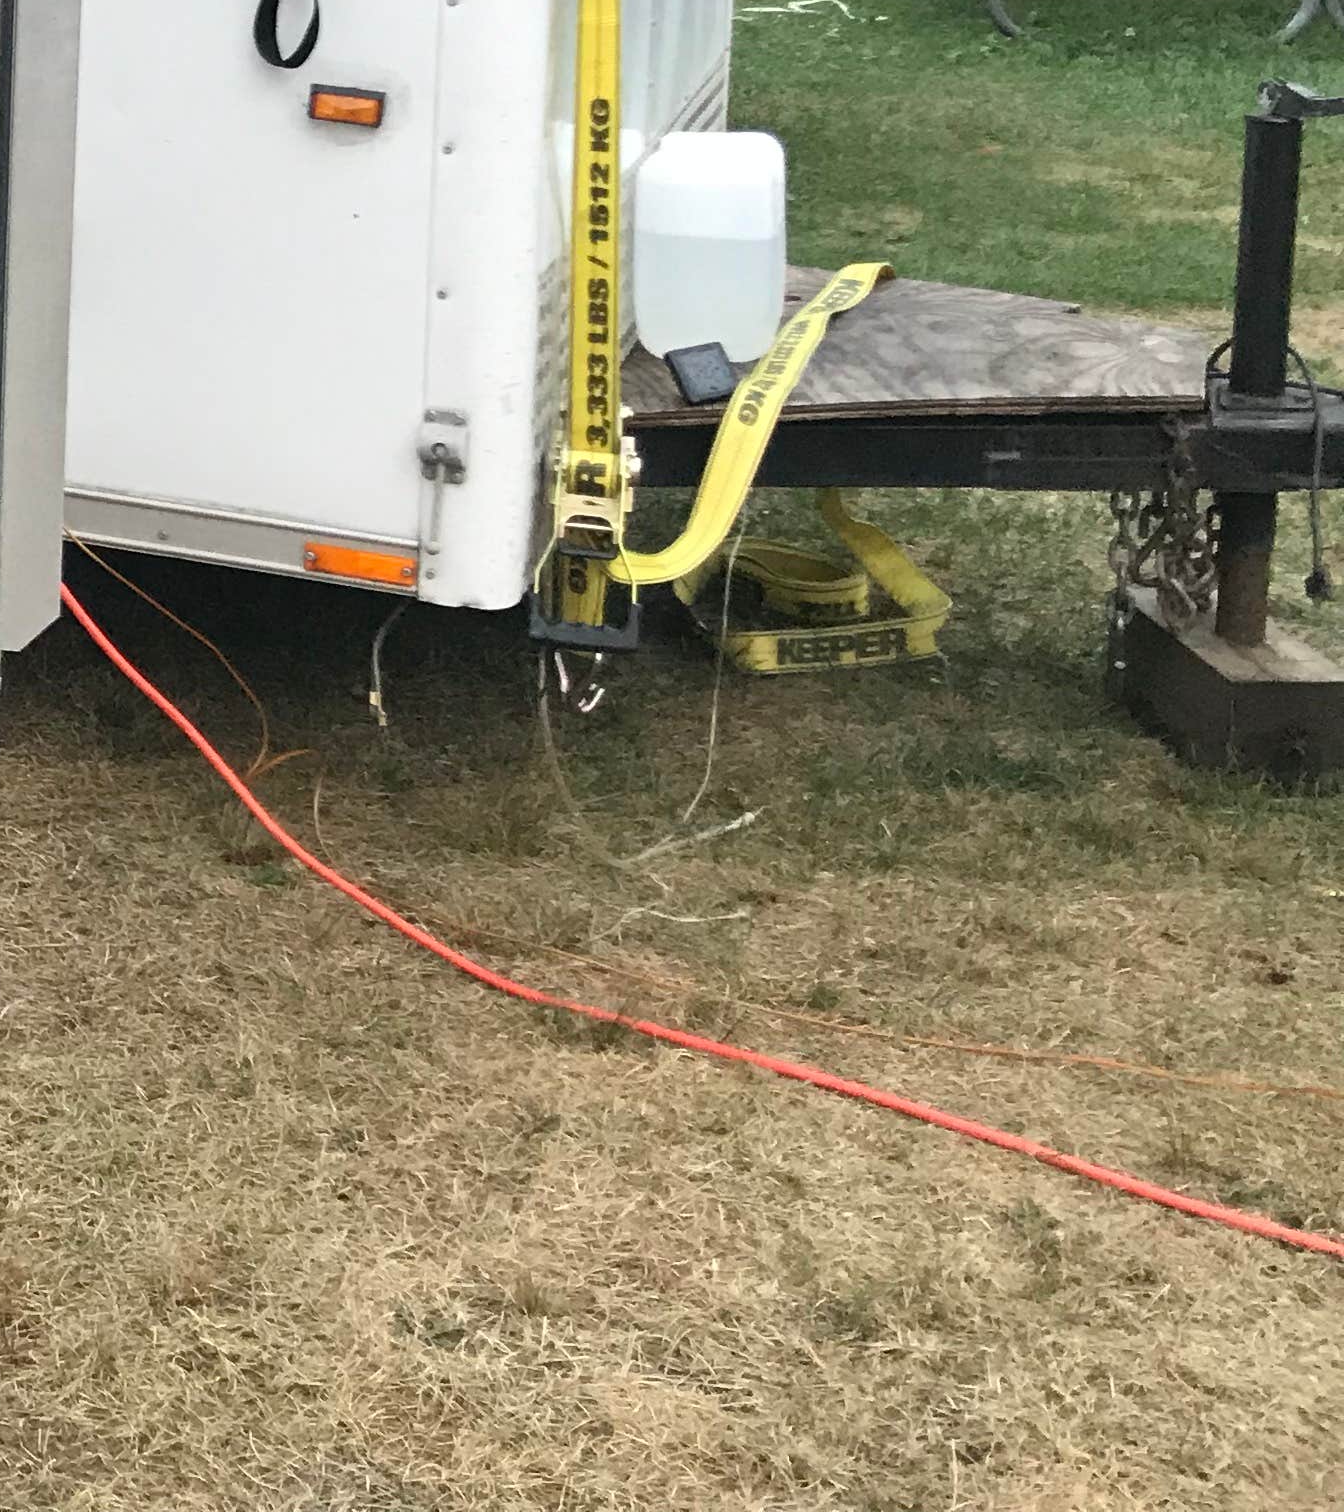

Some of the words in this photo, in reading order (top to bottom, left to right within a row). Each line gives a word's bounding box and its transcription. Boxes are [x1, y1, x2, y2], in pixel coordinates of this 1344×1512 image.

[588, 162, 610, 244] 1512
[587, 278, 610, 344] LBS
[586, 351, 611, 446] 3,333
[777, 628, 906, 667] KEEPER
